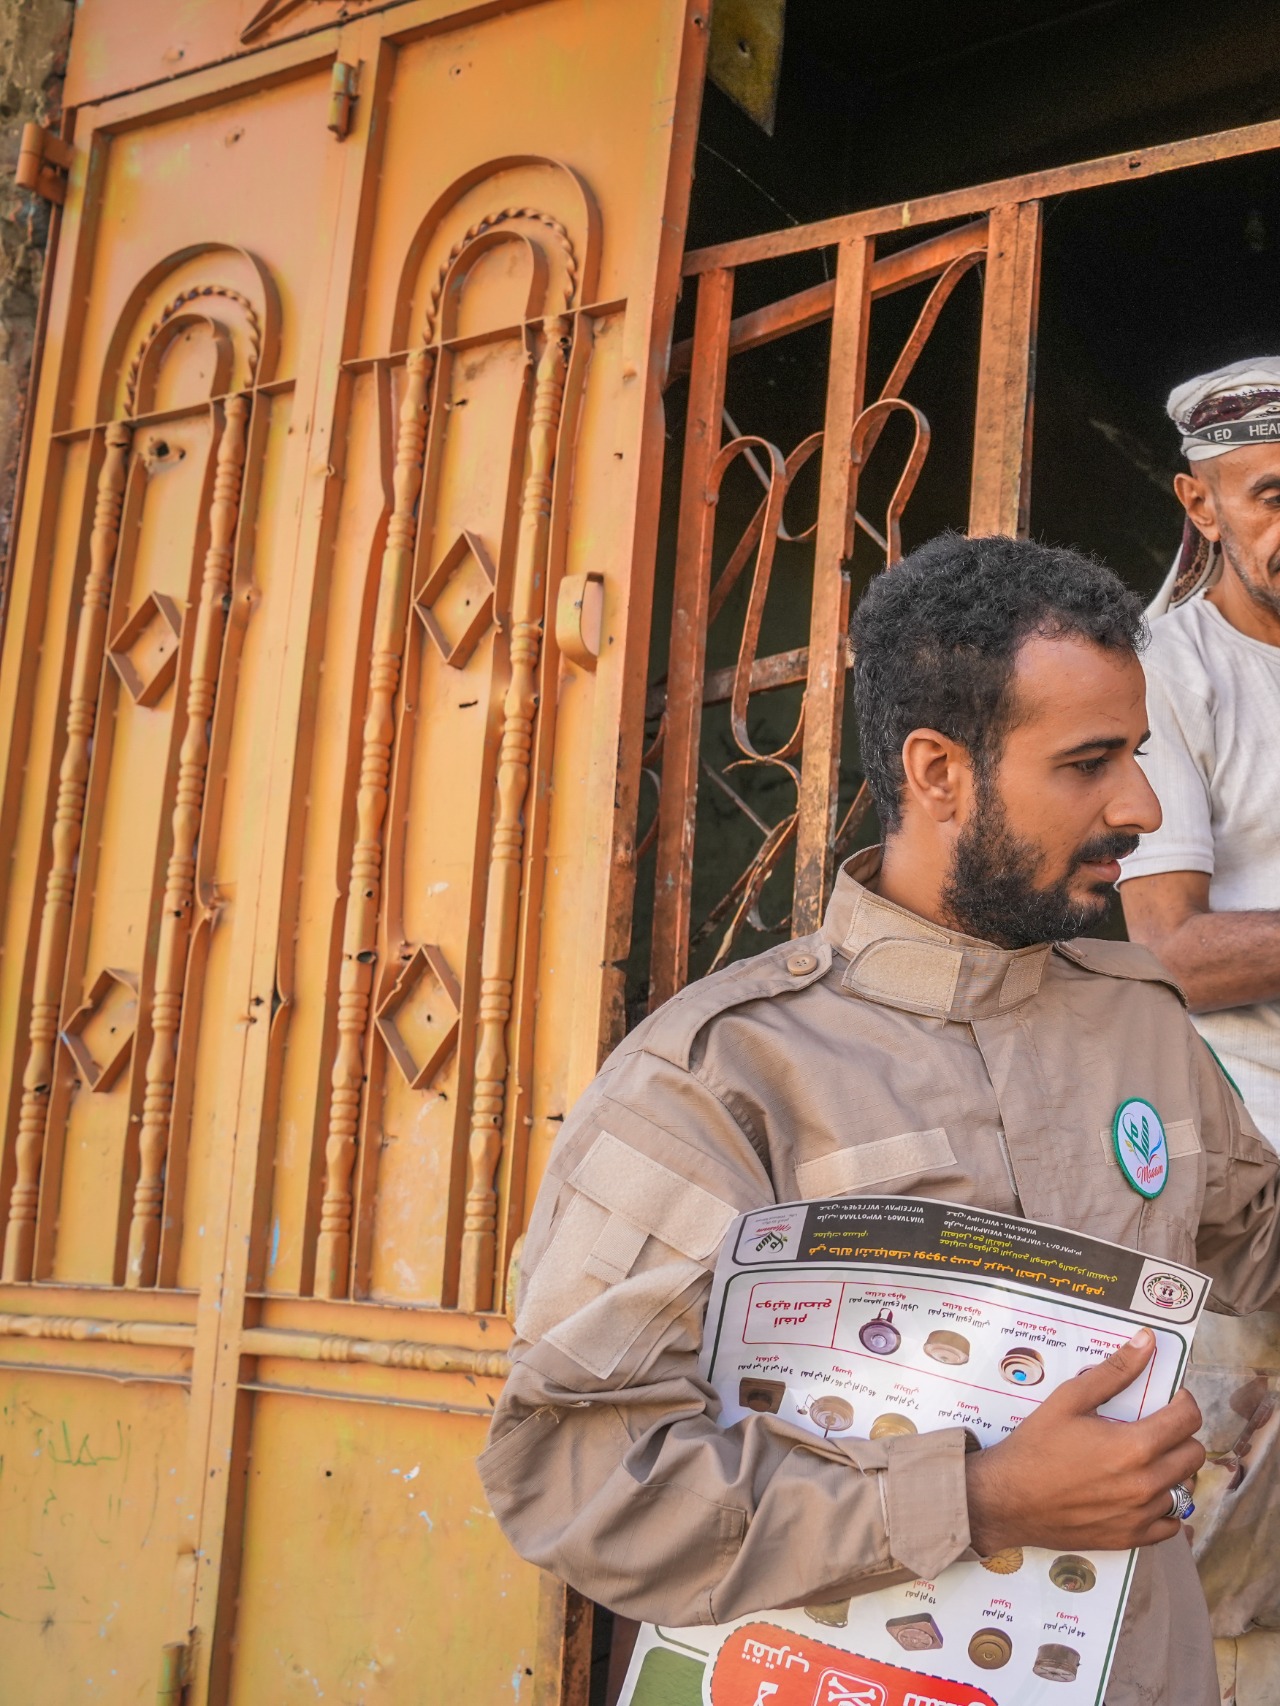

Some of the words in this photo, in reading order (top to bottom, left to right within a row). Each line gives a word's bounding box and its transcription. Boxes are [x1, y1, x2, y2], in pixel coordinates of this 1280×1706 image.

[939, 1238, 968, 1248] عمليات
[968, 1242, 1000, 1254] وطوارئ
[999, 1249, 1030, 1260] البرنامج
[1029, 1256, 1058, 1267] الوطني
[1058, 1262, 1088, 1276] والمركز
[1086, 1270, 1118, 1283] التنفيذي
[808, 1243, 827, 1256] في
[828, 1247, 853, 1256] حالة
[854, 1247, 912, 1260] اشتباهك
[913, 1250, 949, 1263] بوجود
[949, 1255, 983, 1267] جسم
[983, 1261, 1014, 1273] غريب
[1015, 1268, 1047, 1282] اتصل
[1049, 1276, 1071, 1288] على
[1071, 1283, 1106, 1296] الرقم:
[755, 1299, 792, 1312] حوثية
[793, 1298, 833, 1311] الصنع
[773, 1307, 808, 1329] ألغام
[831, 1365, 853, 1378] روسيا
[956, 1401, 980, 1414] روسيا
[990, 1598, 1012, 1613] أميركا
[1055, 1611, 1079, 1624] روسيا
[741, 1638, 810, 1673] تقترب
